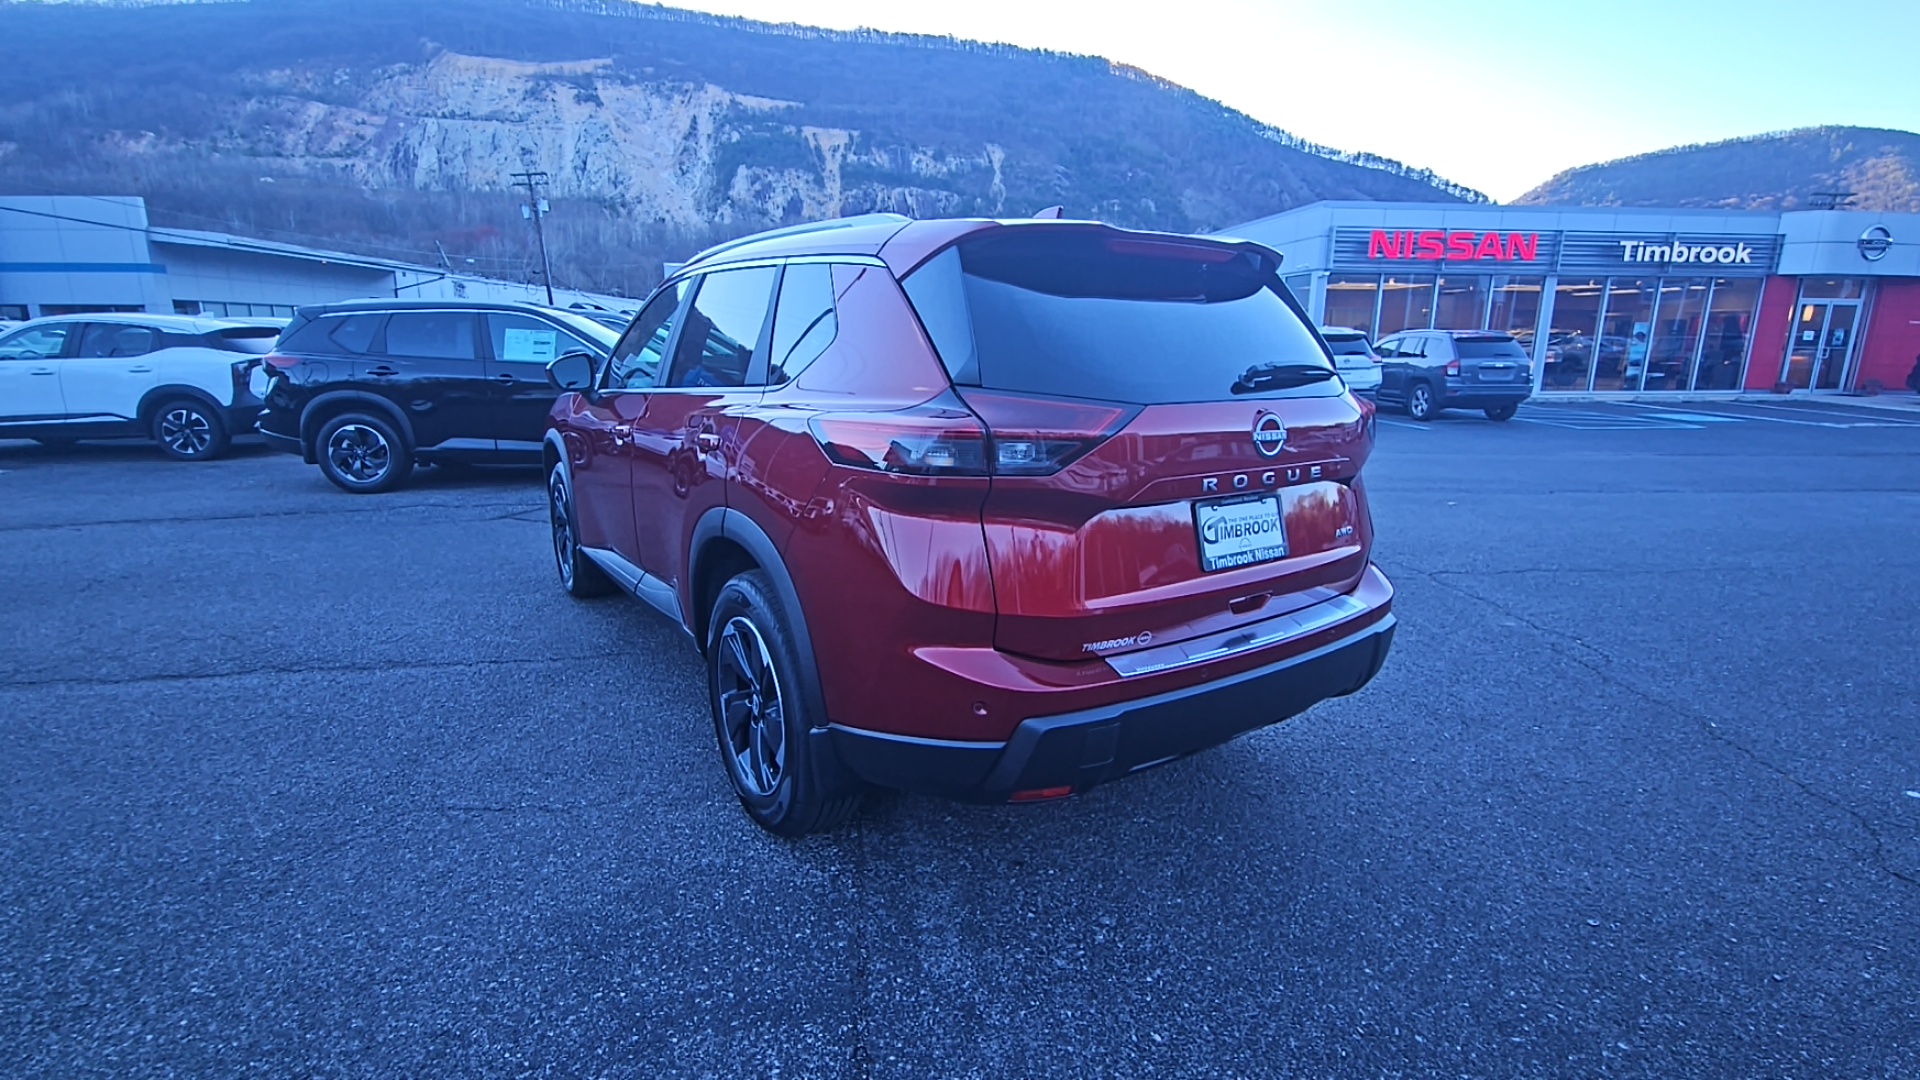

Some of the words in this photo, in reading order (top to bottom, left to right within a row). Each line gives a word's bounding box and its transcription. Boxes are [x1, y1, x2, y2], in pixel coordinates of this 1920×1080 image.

[1368, 229, 1538, 261] NISSAN
[1620, 241, 1752, 263] Timbrook
[1253, 431, 1286, 441] NISSAN
[1202, 466, 1322, 492] ROGUE
[1336, 525, 1353, 538] AWD
[1209, 551, 1254, 570] Timbrook
[1254, 547, 1285, 561] Nissan
[1082, 636, 1137, 652] TIMBROOK
